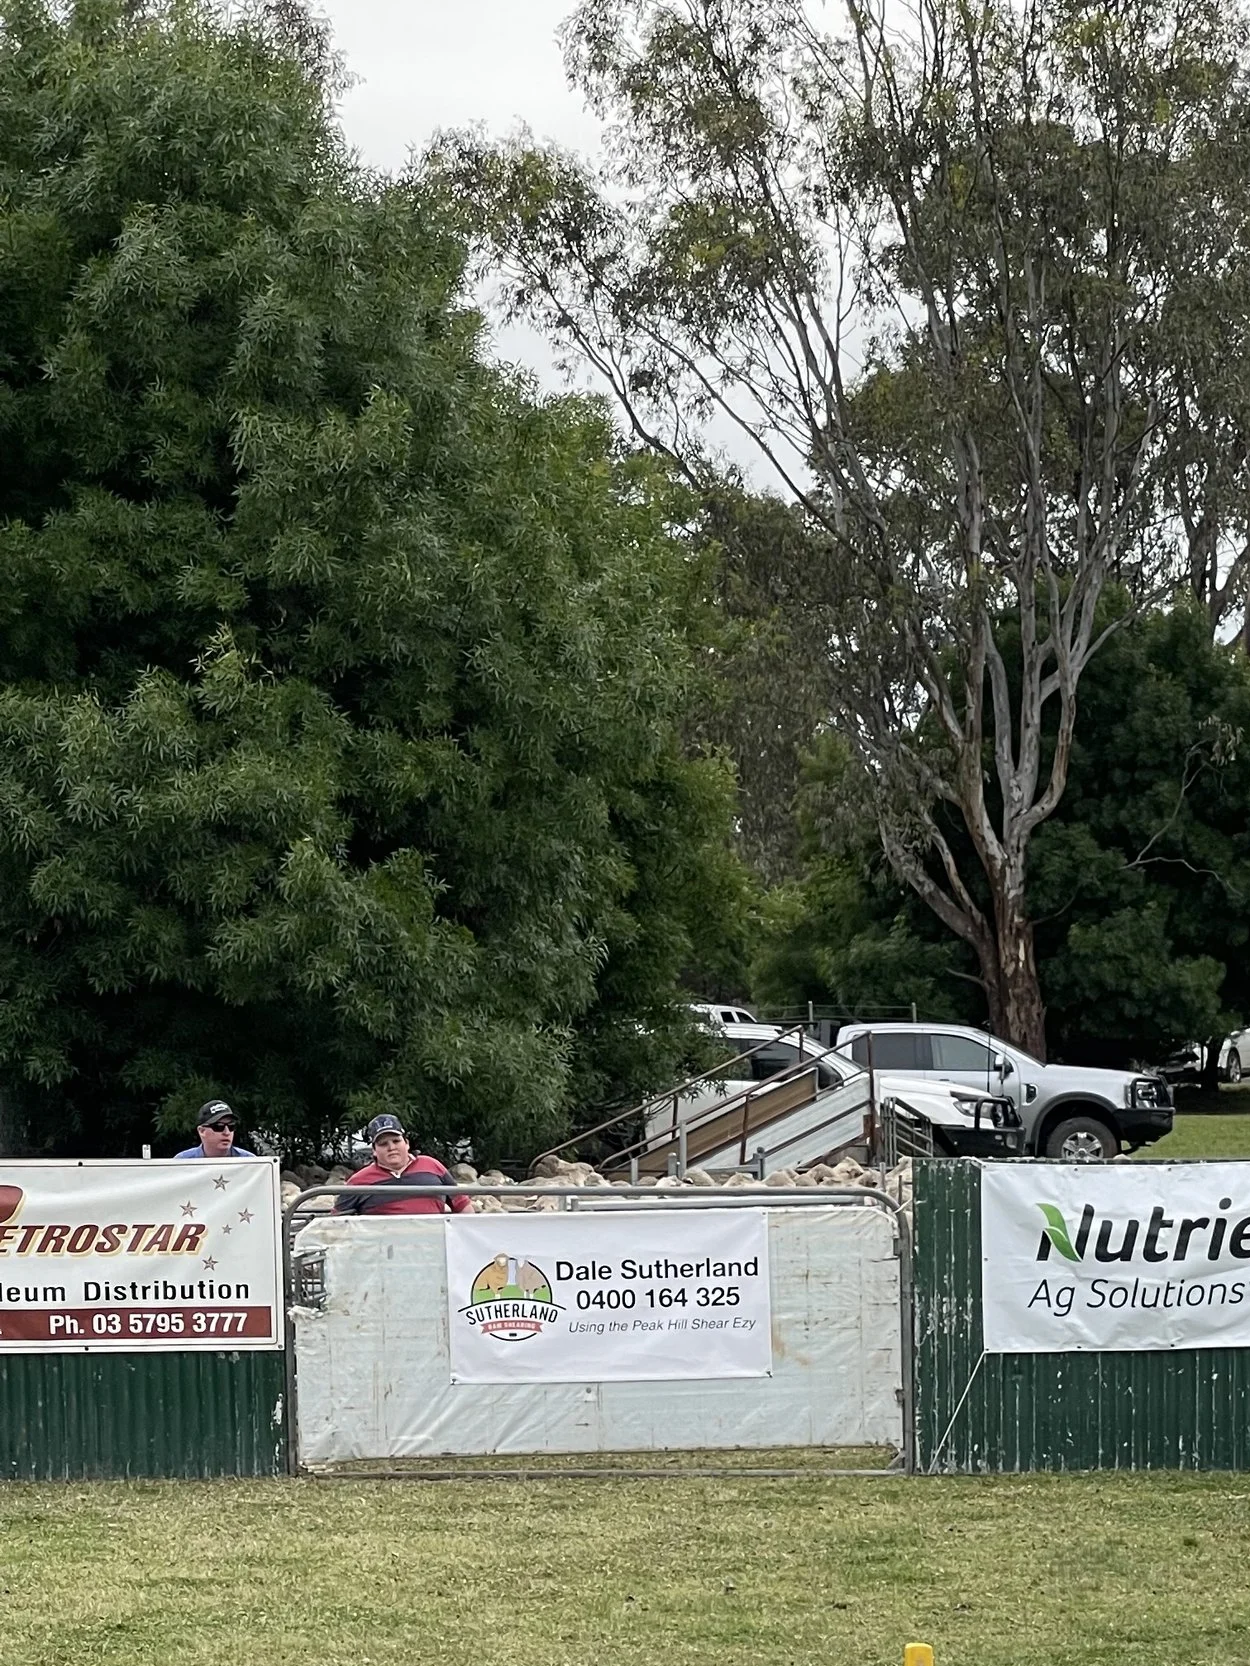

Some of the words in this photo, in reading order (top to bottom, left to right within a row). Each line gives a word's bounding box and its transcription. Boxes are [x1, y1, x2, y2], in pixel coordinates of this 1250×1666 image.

[556, 1260, 613, 1281] Dale
[620, 1256, 759, 1280] Sutherland
[84, 1279, 250, 1302] Distribution
[576, 1289, 636, 1310] 0400
[645, 1287, 689, 1309] 164
[696, 1285, 741, 1308] 325
[1028, 1280, 1074, 1317] Ag
[50, 1314, 85, 1336] Ph.
[93, 1313, 122, 1335] 03
[129, 1313, 185, 1334] 5795
[192, 1311, 248, 1333] 3777
[465, 1303, 559, 1326] SUTHERLAND
[568, 1321, 605, 1336] Using
[608, 1320, 628, 1333] the
[632, 1319, 664, 1332] Peak
[668, 1318, 688, 1332] Hill
[691, 1317, 729, 1331] Shear
[733, 1316, 757, 1331] Ezy
